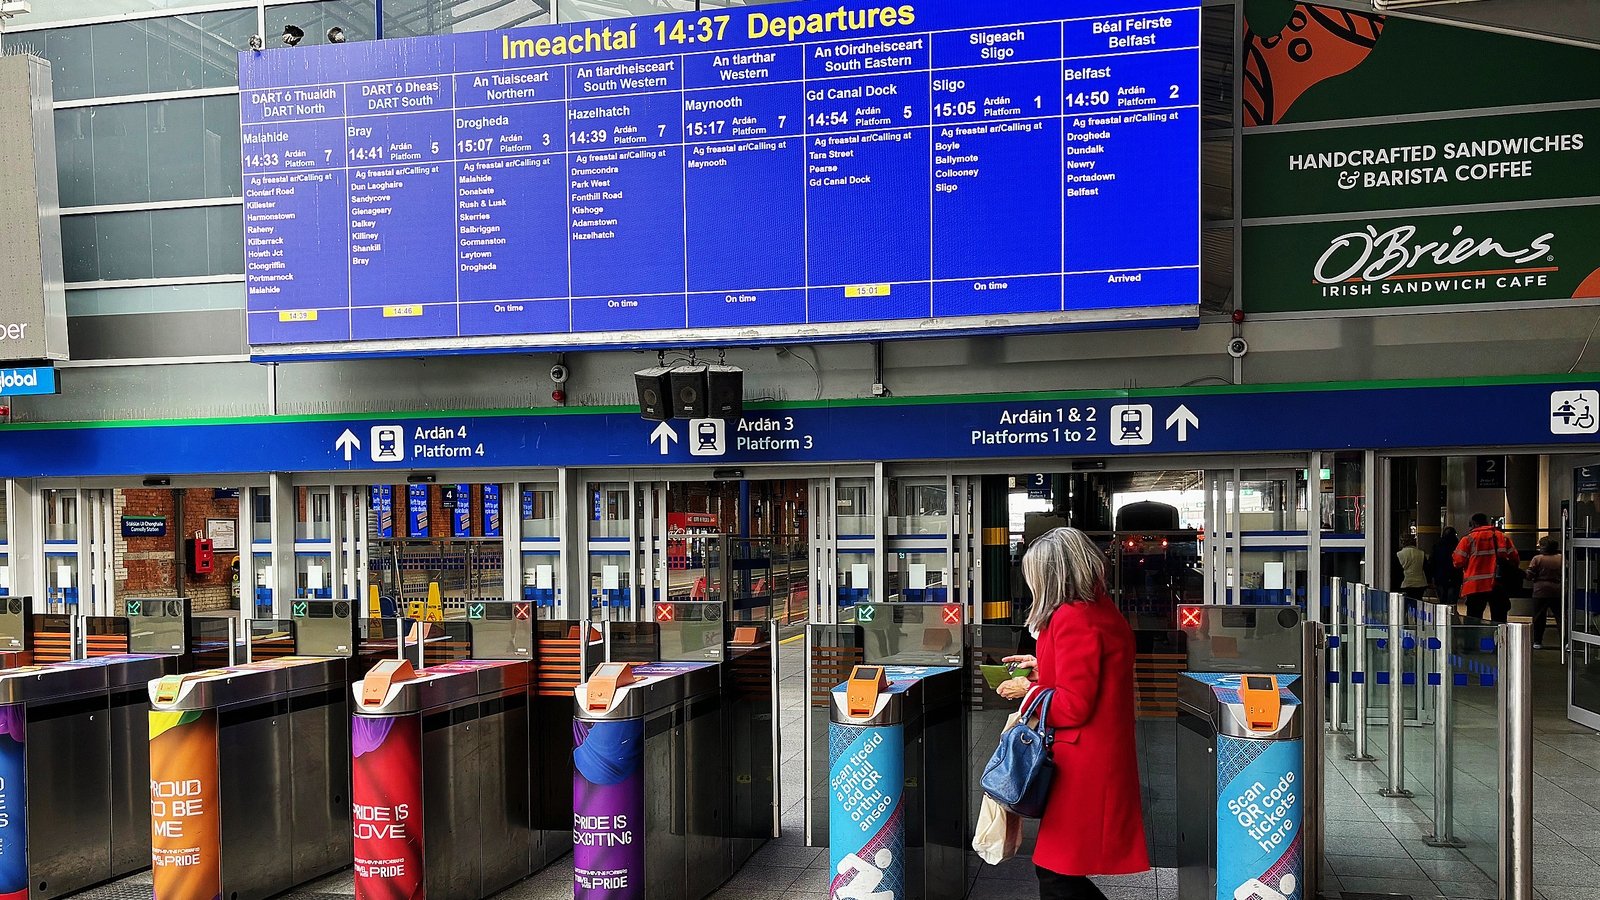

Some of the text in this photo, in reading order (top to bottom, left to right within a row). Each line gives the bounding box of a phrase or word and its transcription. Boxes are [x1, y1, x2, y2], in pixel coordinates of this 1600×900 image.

[502, 3, 915, 60] Imeachtaí 14:37 Departures
[1093, 17, 1172, 33] Béal Feirste
[969, 28, 1024, 45] Sligeach
[1109, 34, 1155, 48] Belfast
[815, 39, 922, 57] An tOirdheisceart
[981, 47, 1014, 60] Sligo
[713, 56, 729, 66] An
[825, 56, 911, 71] South Eastern
[474, 70, 548, 87] An Tuaisceart
[577, 68, 592, 78] An
[720, 69, 768, 80] Western
[1065, 67, 1111, 80] Belfast
[362, 82, 440, 96] DART ó Dheas
[584, 77, 666, 92] South Western
[933, 79, 965, 92] Sligo
[1118, 85, 1179, 98] Ardán 2
[252, 88, 336, 104] DART ó Thuaidh
[487, 88, 534, 100] Northern
[807, 84, 897, 101] Gd Canal Dock
[1066, 91, 1109, 107] 14:50
[369, 95, 432, 109] DART South
[686, 96, 742, 112] Maynooth
[984, 96, 1040, 108] Ardán 1
[1118, 97, 1156, 106] Platform
[569, 106, 629, 120] Hazelhatch
[855, 106, 912, 118] Ardán 5
[934, 101, 976, 117] 15:05
[984, 107, 1020, 115] Platform
[457, 115, 508, 129] Drogheda
[808, 111, 848, 126] 14:54
[856, 118, 891, 126] Platform
[1073, 119, 1085, 128] Ag
[1088, 116, 1121, 125] freastal
[348, 127, 372, 138] Bray
[686, 121, 725, 135] 15:17
[242, 131, 288, 144] Malahide
[500, 134, 550, 145] Ardán 3
[570, 130, 606, 144] 14:39
[1067, 131, 1110, 141] Drogheda
[349, 146, 382, 160] 14:41
[458, 138, 493, 154] 15:07
[500, 144, 531, 152] Platform
[936, 142, 960, 151] Boyle
[1067, 145, 1104, 155] Dundalk
[1290, 134, 1583, 171] HANDCRAFTED SANDWICHES
[245, 153, 278, 168] 14:33
[829, 150, 853, 158] Street
[936, 155, 978, 164] Ballymote
[688, 158, 726, 169] Maynooth
[1067, 161, 1095, 169] Newry
[460, 175, 492, 183] Malahide
[824, 177, 847, 185] Canal
[850, 175, 870, 183] Dock
[936, 169, 978, 177] Collooney
[1067, 173, 1115, 182] Portadown
[1338, 161, 1531, 189] & BARISTA COFFEE
[460, 188, 494, 196] Donabate
[936, 183, 957, 193] Sligo
[1067, 188, 1098, 196] Belfast
[460, 213, 490, 221] Skerries
[460, 225, 500, 234] Balbriggan
[460, 238, 505, 246] Gormanston
[461, 252, 491, 260] Laytown
[1313, 224, 1554, 284] O'Briens
[461, 263, 496, 272] Drogheda
[1108, 274, 1141, 282] Arrived
[1323, 275, 1546, 296] IRISH SANDWICH CAFE
[0, 369, 38, 393] lobal
[1000, 407, 1096, 424] Ardáin 1 & 2
[738, 417, 793, 431] Ardán 3
[415, 426, 466, 439] Ardán 4
[972, 427, 1096, 444] Platforms 1 to 2
[738, 436, 812, 450] Platform 3
[415, 444, 484, 457] Platform 4
[1035, 474, 1043, 485] 3
[446, 490, 453, 499] 4
[831, 732, 882, 790] Scan ticéid
[836, 760, 873, 801] a bhfuil
[843, 770, 882, 811] cód QR
[1228, 781, 1265, 815] Scan
[1238, 772, 1295, 827] QR code
[172, 799, 203, 816] BE
[353, 803, 408, 821] PRIDE IS
[851, 790, 882, 821] orthu
[860, 796, 891, 831] anseo
[1248, 793, 1295, 840] tickets
[574, 813, 627, 829] PRIDE IS
[154, 820, 183, 837] ME
[573, 829, 632, 846] EXCITING
[1258, 819, 1292, 853] here
[165, 854, 200, 866] PRIDE
[370, 865, 404, 877] PRIDE
[593, 876, 628, 889] PRIDE
